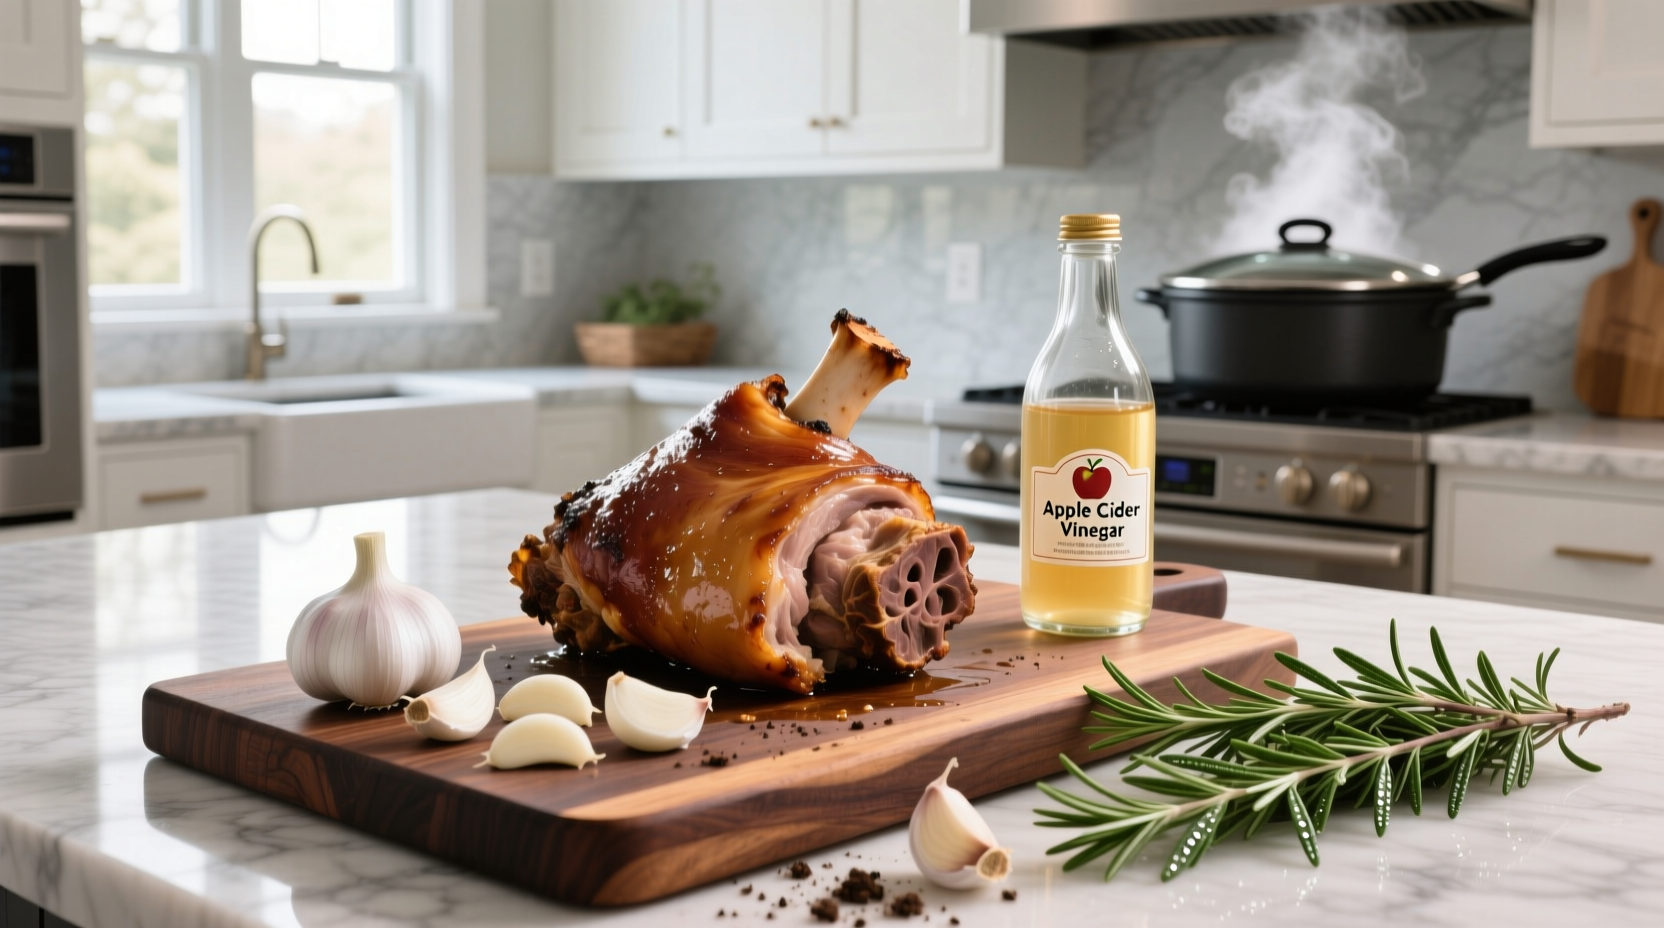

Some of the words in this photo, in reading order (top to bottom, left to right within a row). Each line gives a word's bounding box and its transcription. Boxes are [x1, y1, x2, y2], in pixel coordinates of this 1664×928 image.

[1042, 500, 1091, 520] Apple
[1096, 501, 1141, 518] Cider
[1060, 521, 1125, 541] Vinegar
